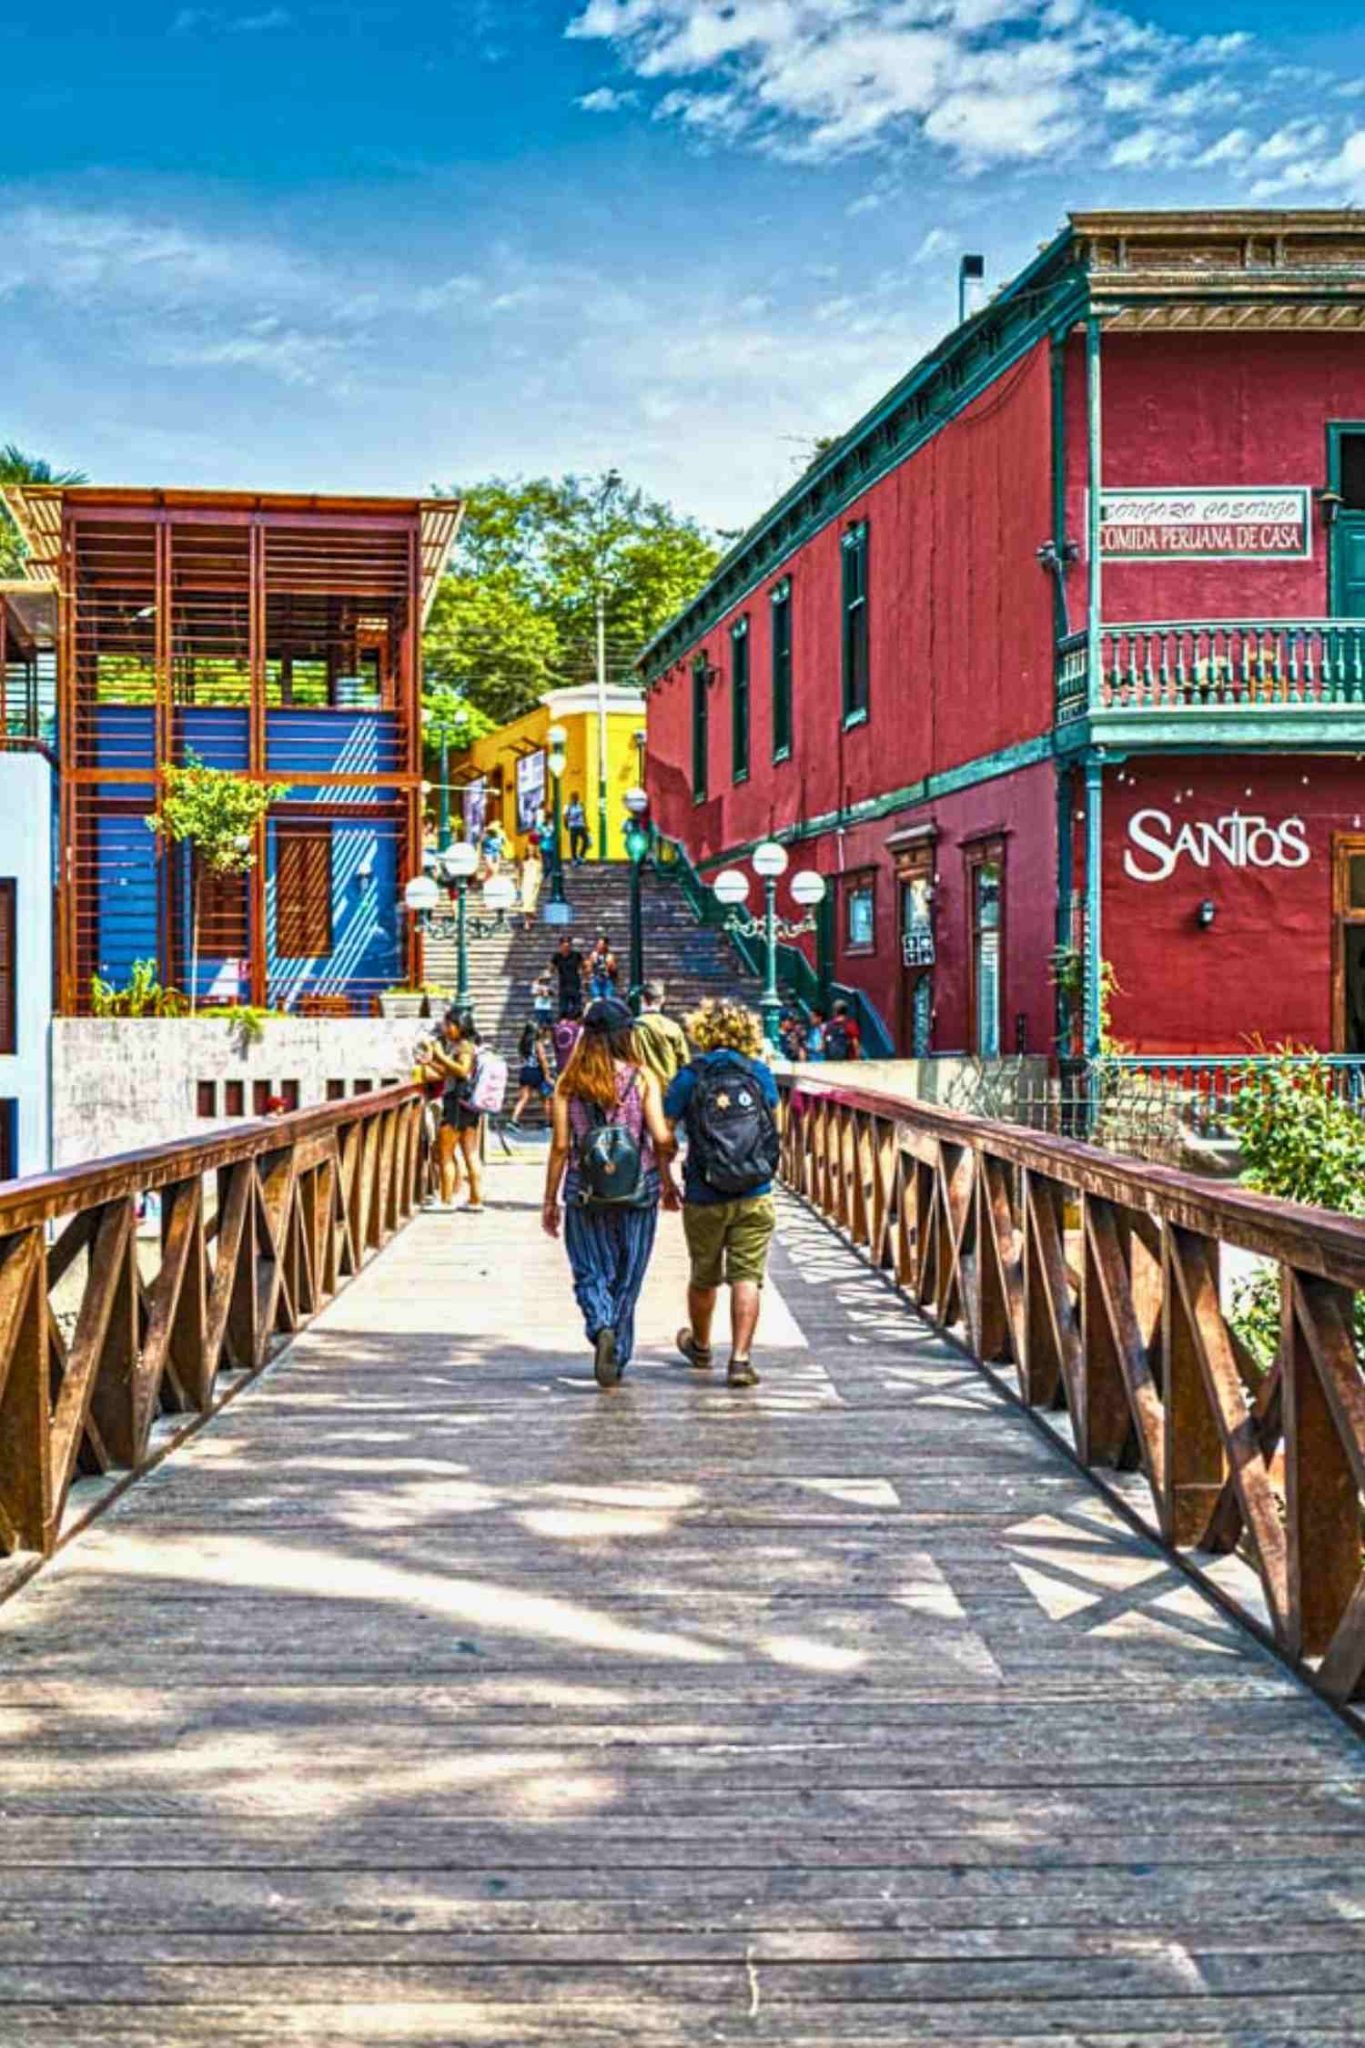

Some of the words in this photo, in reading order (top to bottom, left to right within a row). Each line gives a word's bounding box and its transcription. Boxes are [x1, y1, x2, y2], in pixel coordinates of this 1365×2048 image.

[1161, 526, 1234, 550] PERUANA
[1236, 526, 1258, 549] DE
[1260, 525, 1302, 549] CASA
[1123, 807, 1311, 882] SANTOS
